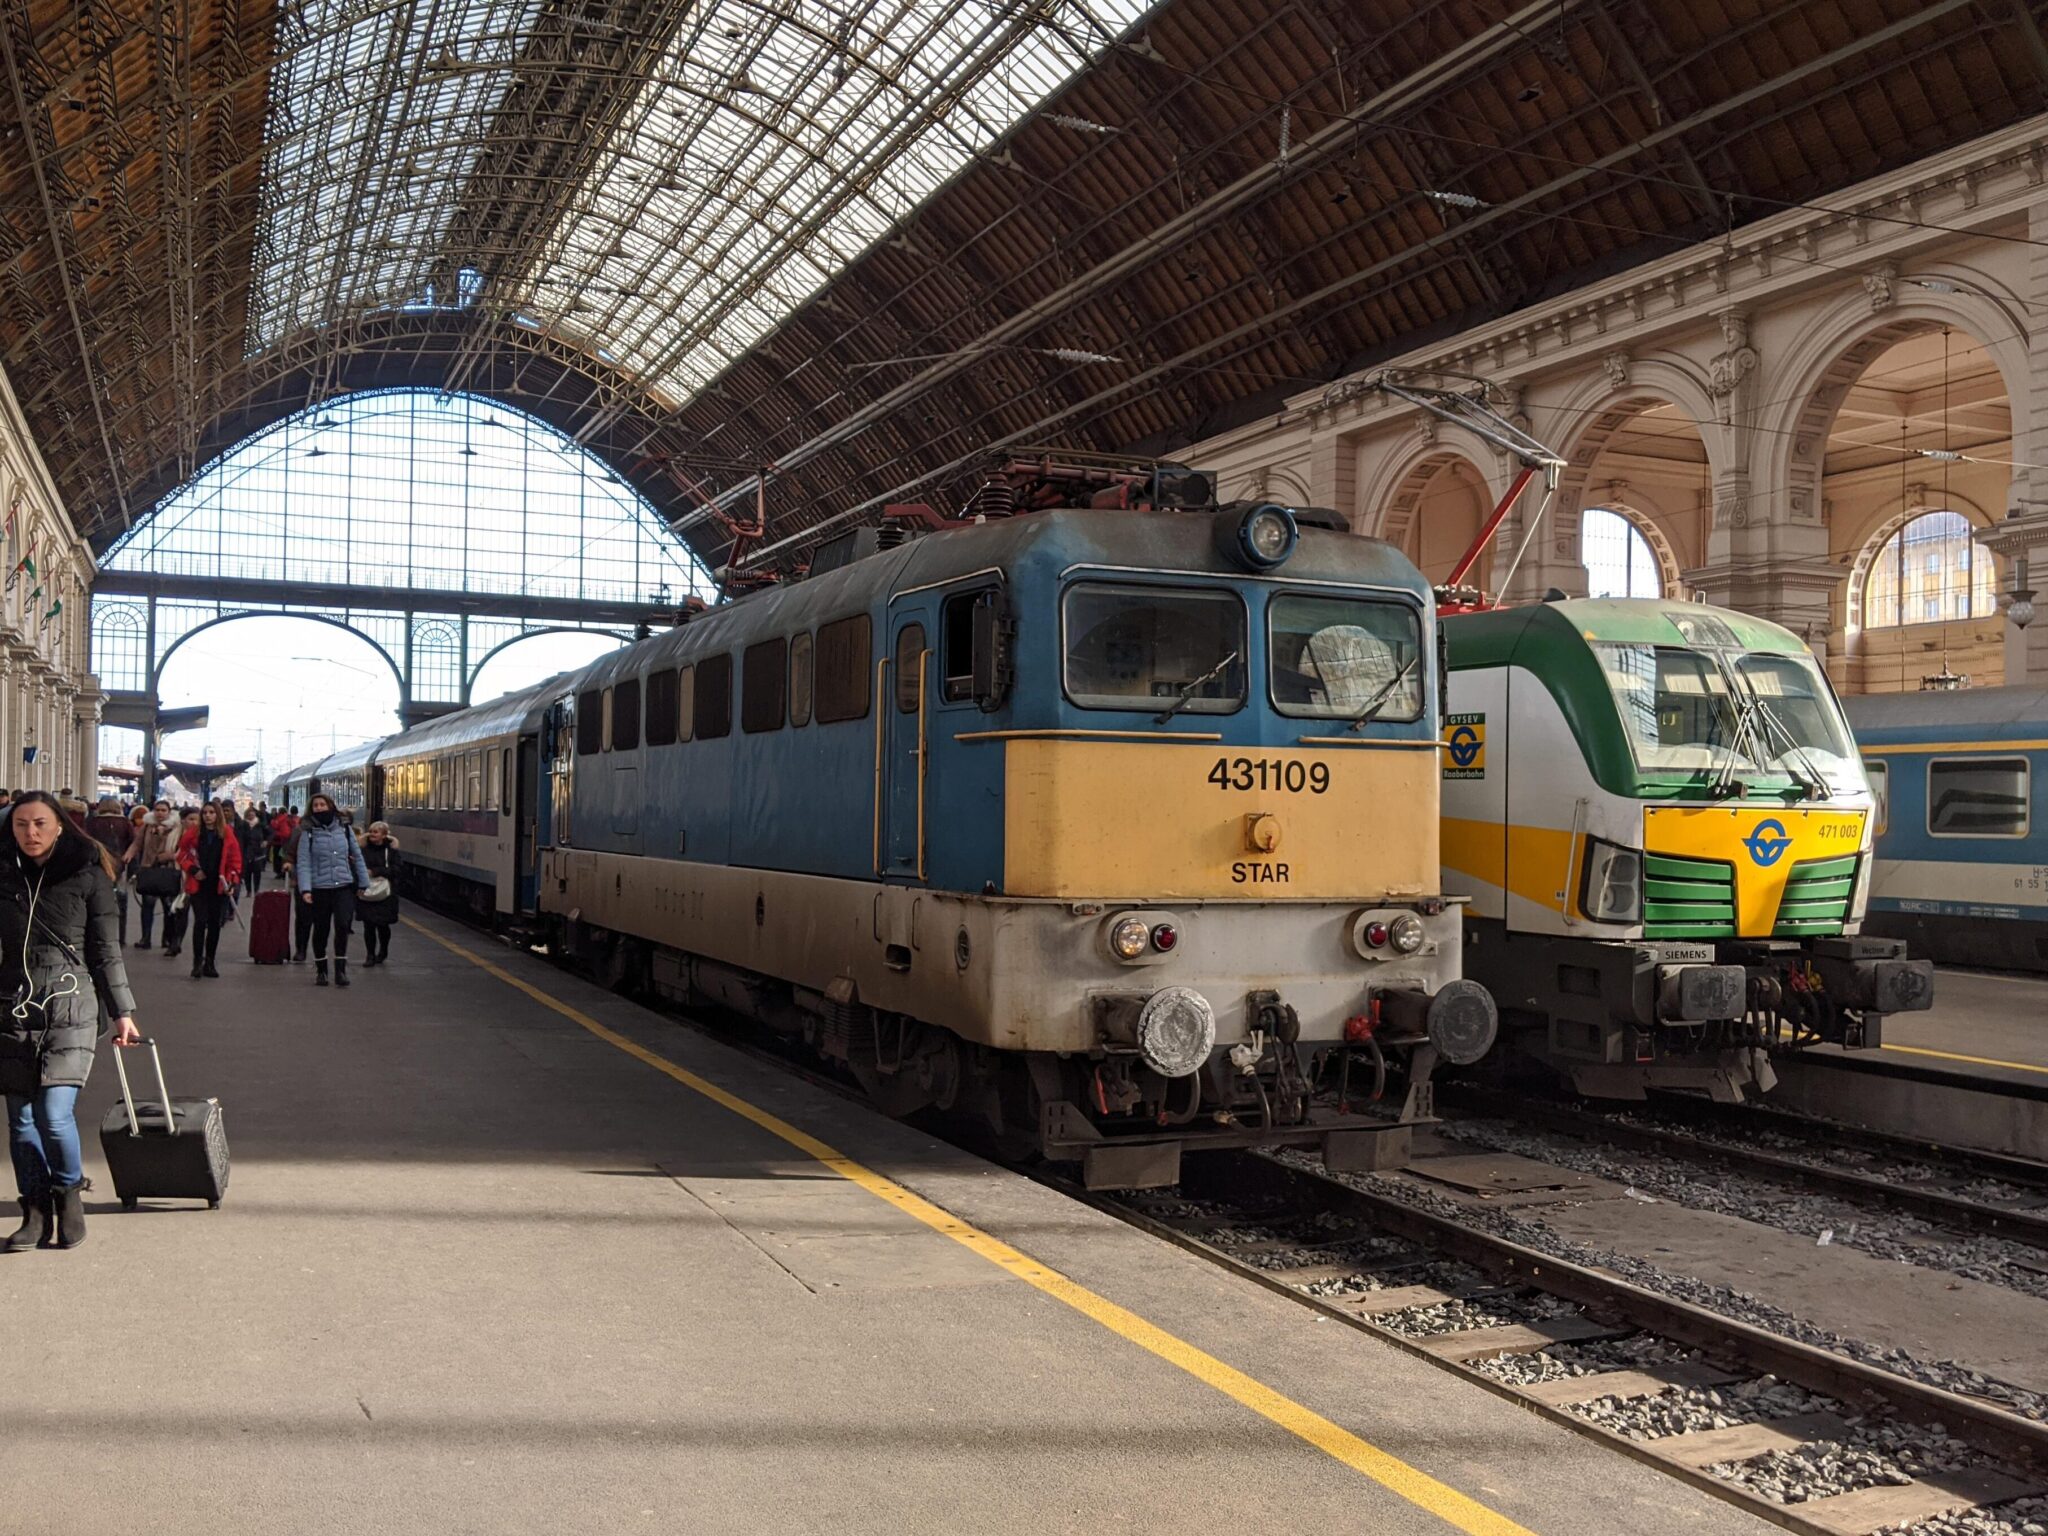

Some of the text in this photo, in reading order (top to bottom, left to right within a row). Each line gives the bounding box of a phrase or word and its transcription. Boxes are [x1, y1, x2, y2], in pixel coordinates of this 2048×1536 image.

[1450, 714, 1479, 724] GYSEV
[1207, 757, 1330, 794] 431109
[1818, 824, 1858, 839] 471 003
[1231, 862, 1289, 883] STAR
[1665, 950, 1707, 960] SIEMENS
